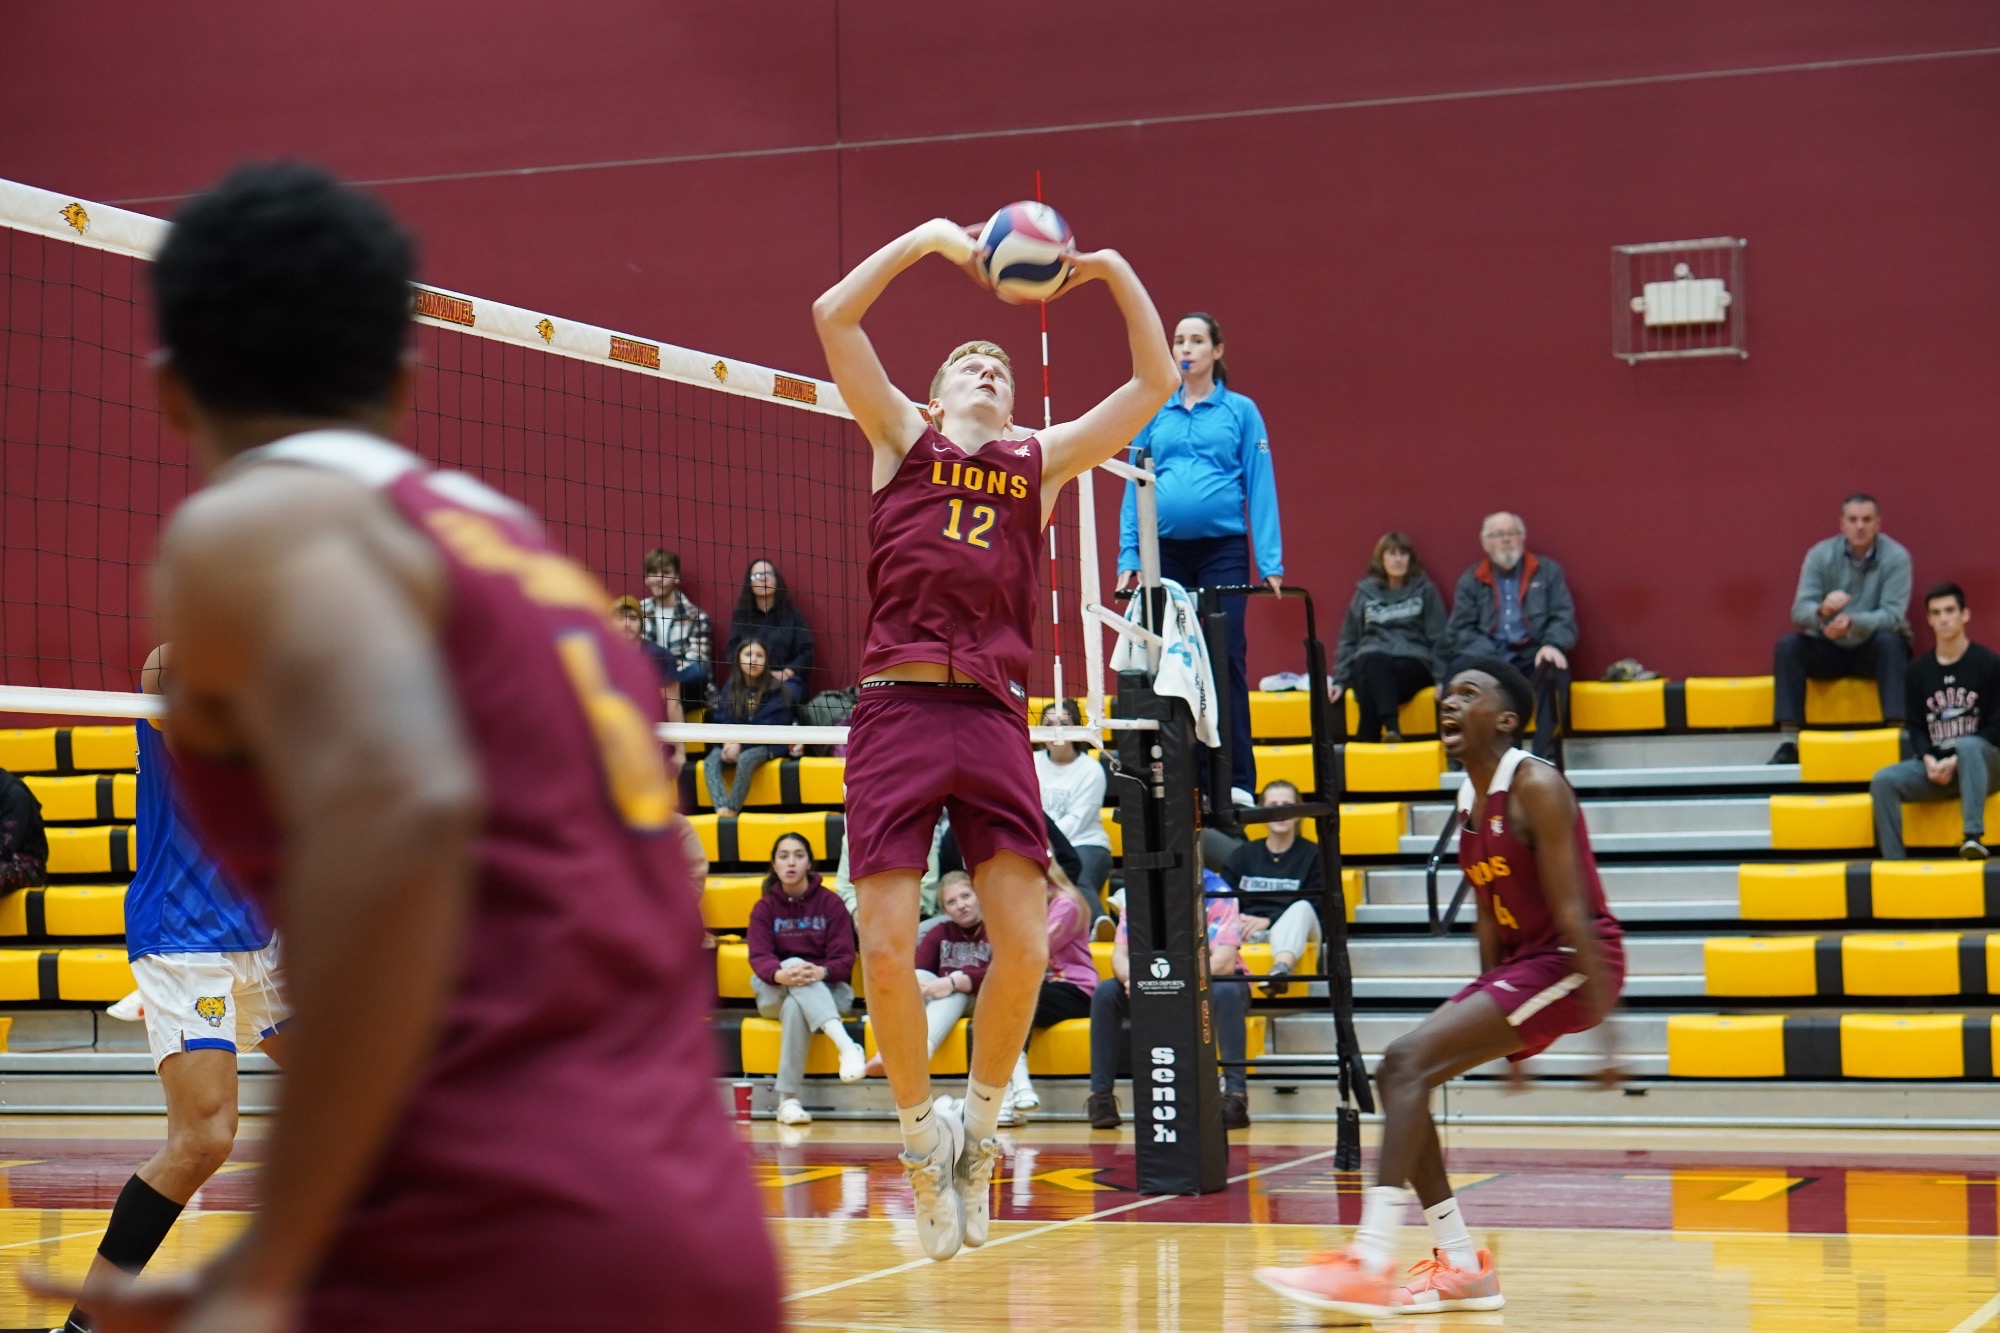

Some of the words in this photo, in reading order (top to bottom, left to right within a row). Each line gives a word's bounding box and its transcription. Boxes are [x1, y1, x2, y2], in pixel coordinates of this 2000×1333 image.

[413, 287, 475, 327] EMMANUEL
[608, 335, 661, 370] EMMANUEL
[931, 461, 1028, 499] LIONS
[943, 498, 996, 550] 12
[1493, 894, 1519, 930] 4
